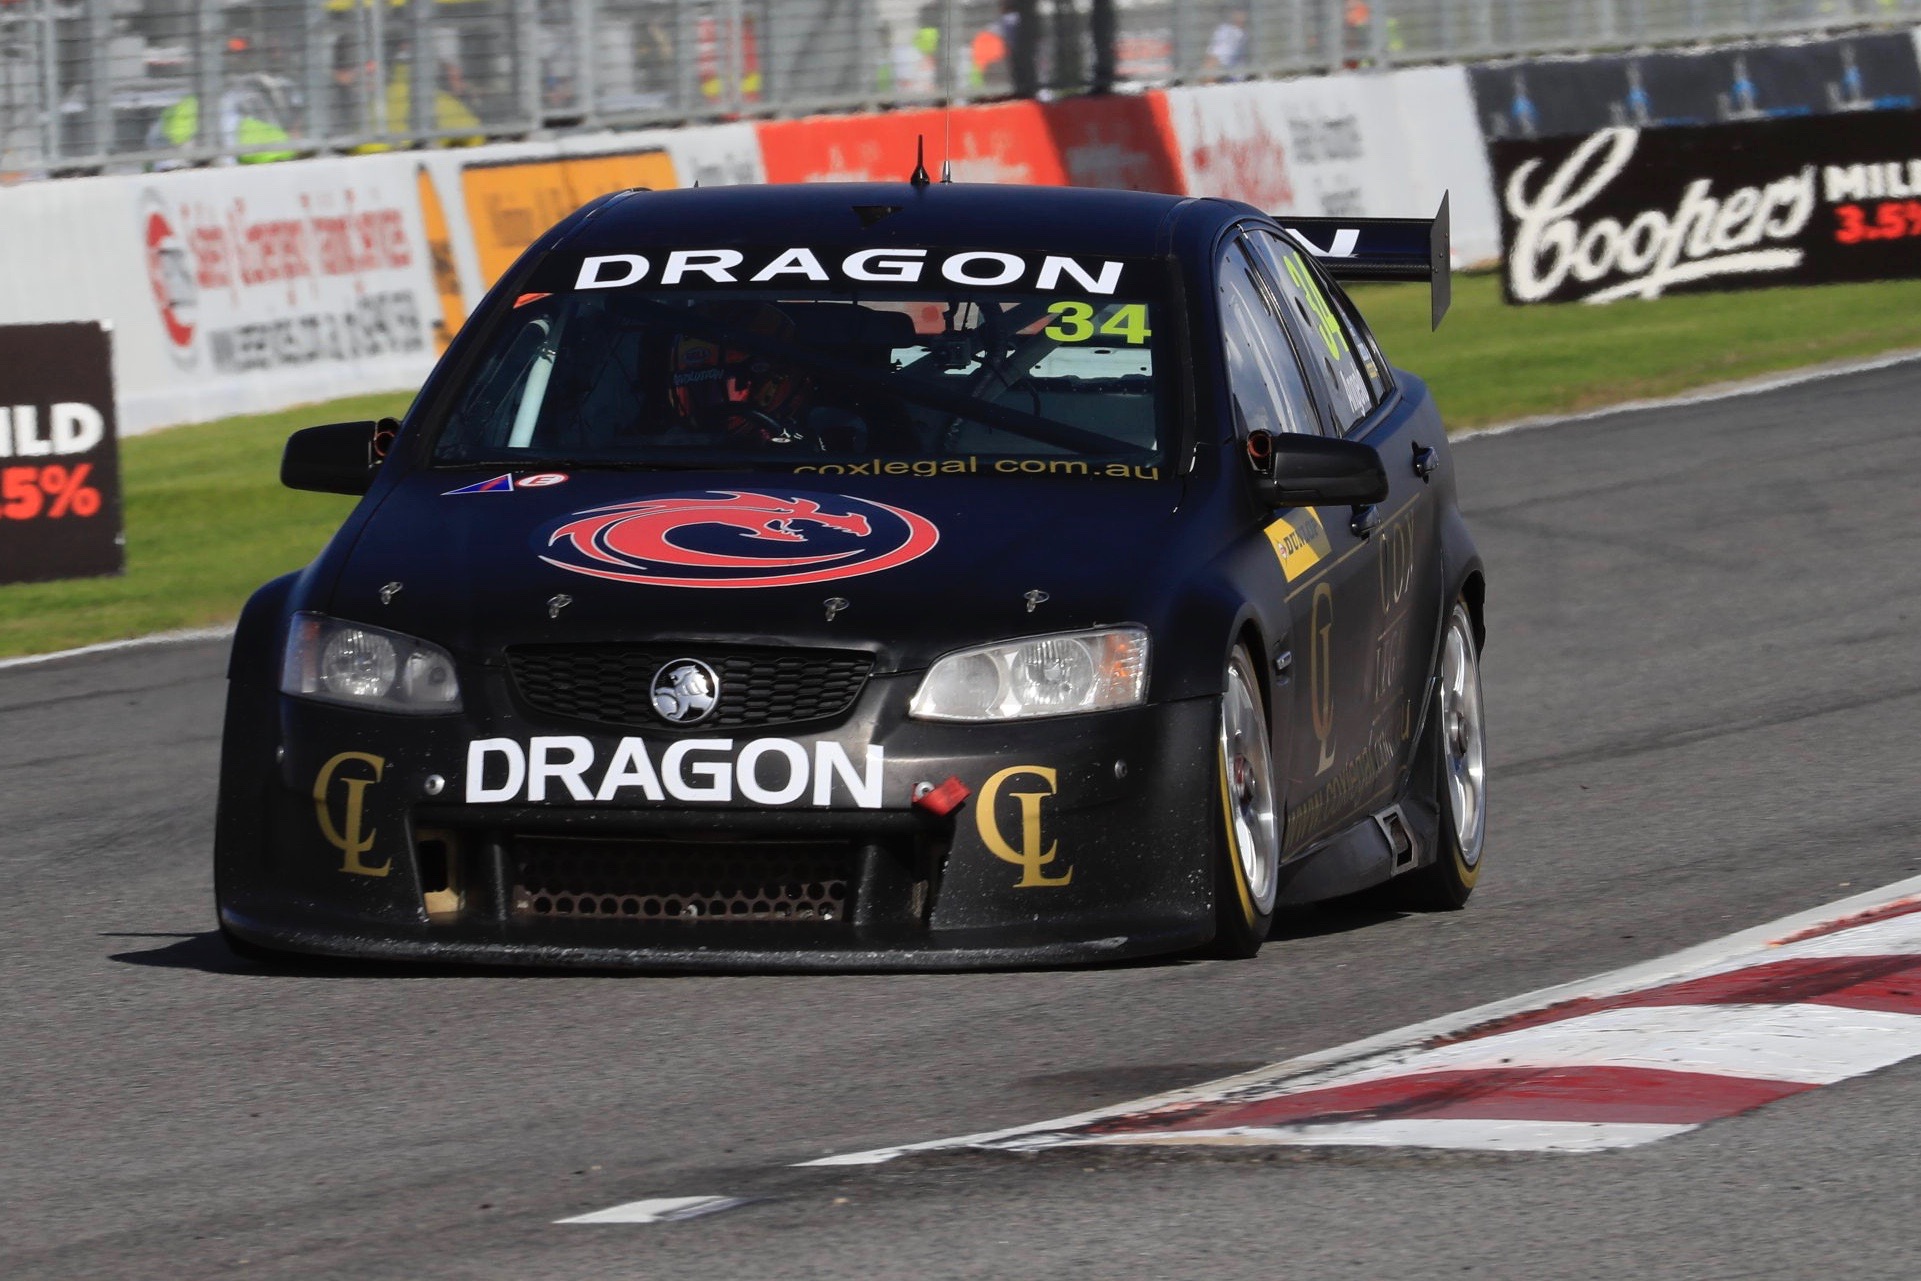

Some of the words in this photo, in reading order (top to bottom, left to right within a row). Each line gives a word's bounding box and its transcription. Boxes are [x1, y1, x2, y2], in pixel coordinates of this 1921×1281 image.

[1506, 126, 1817, 301] Coopers
[574, 247, 1125, 295] DRAGON
[1044, 301, 1152, 344] 34
[0, 463, 102, 520] 5%
[465, 735, 885, 809] DRAGON
